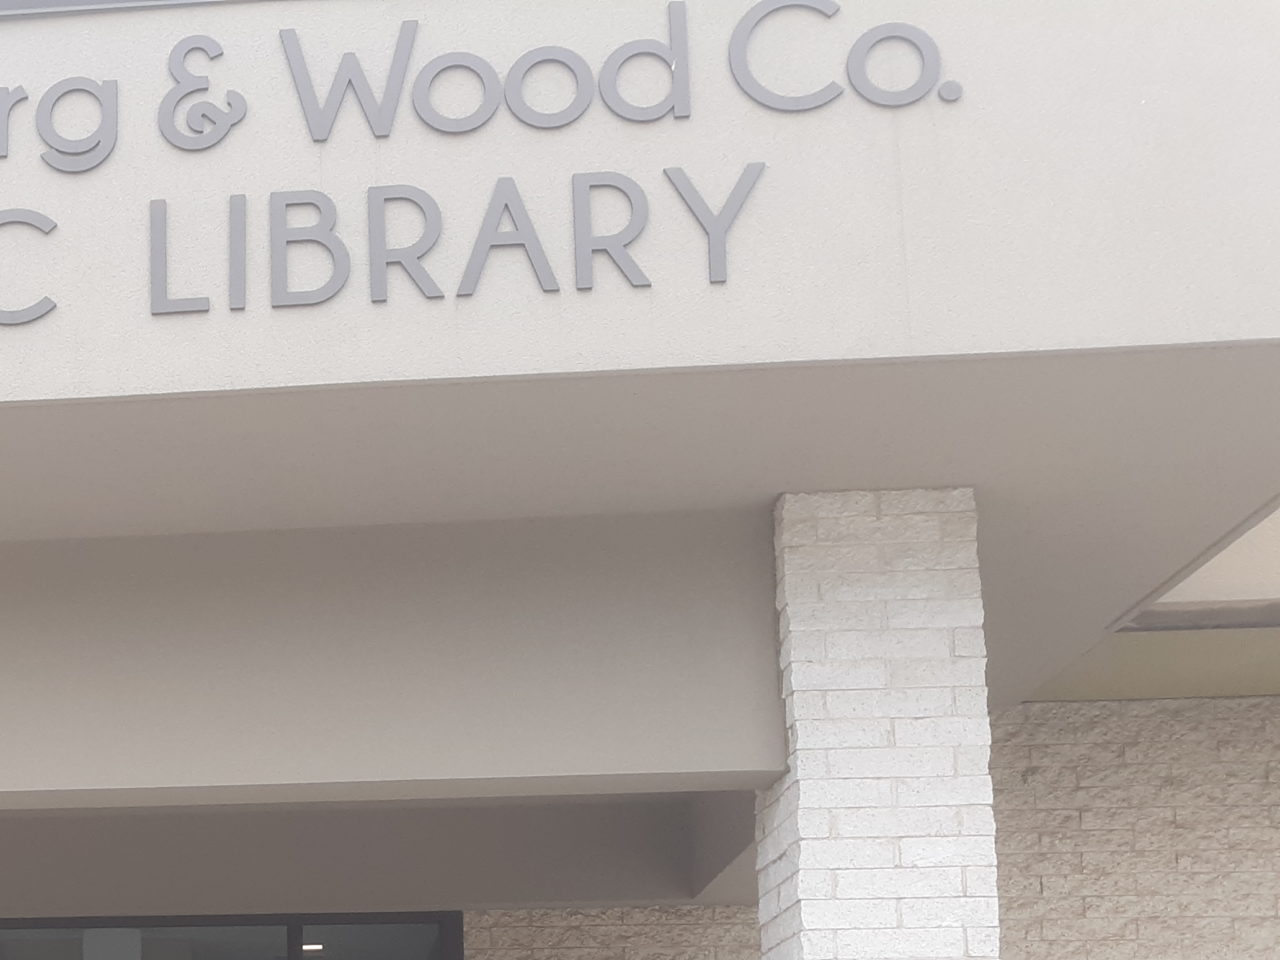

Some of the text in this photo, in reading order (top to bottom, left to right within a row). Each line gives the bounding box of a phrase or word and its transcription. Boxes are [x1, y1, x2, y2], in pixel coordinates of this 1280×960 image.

[158, 34, 247, 151] &
[279, 0, 692, 143] Wood
[728, 0, 963, 112] Co.
[149, 162, 766, 315] LIBRARY
